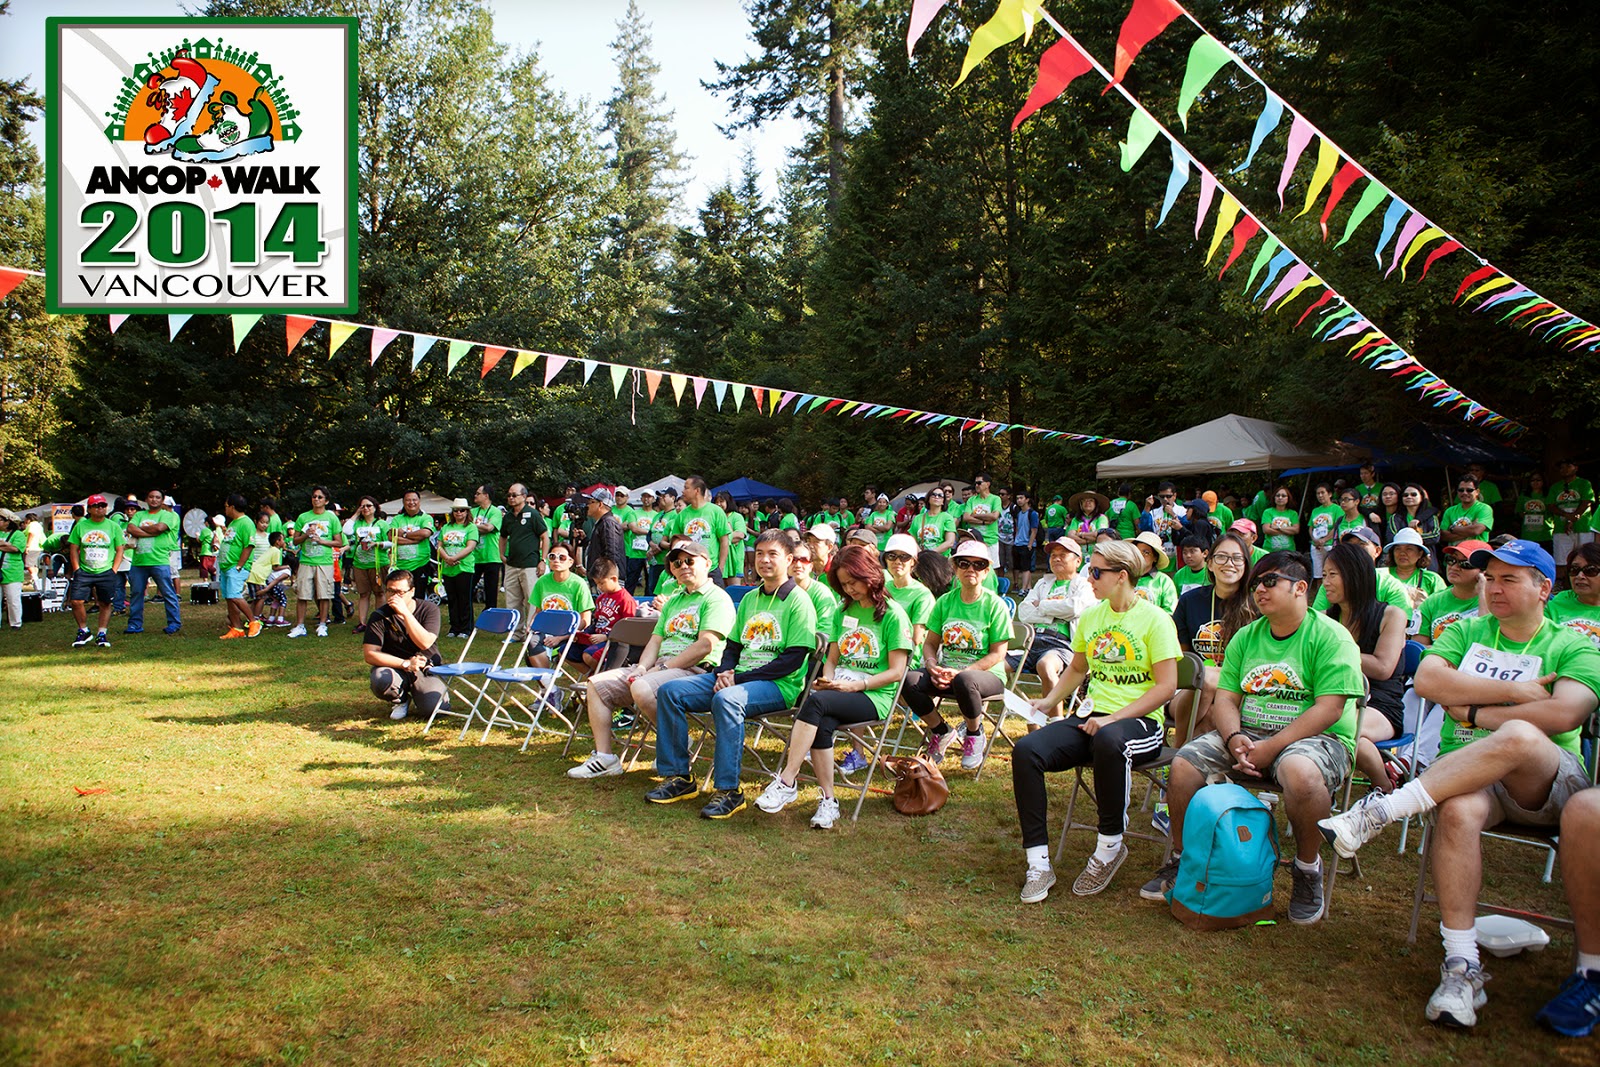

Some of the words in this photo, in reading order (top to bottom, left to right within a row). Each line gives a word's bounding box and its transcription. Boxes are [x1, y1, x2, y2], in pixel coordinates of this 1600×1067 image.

[856, 660, 880, 670] WALK
[1474, 661, 1524, 681] 0167
[1113, 671, 1152, 685] WALK
[1275, 689, 1311, 702] WALK
[1266, 702, 1299, 712] CRANBROOK
